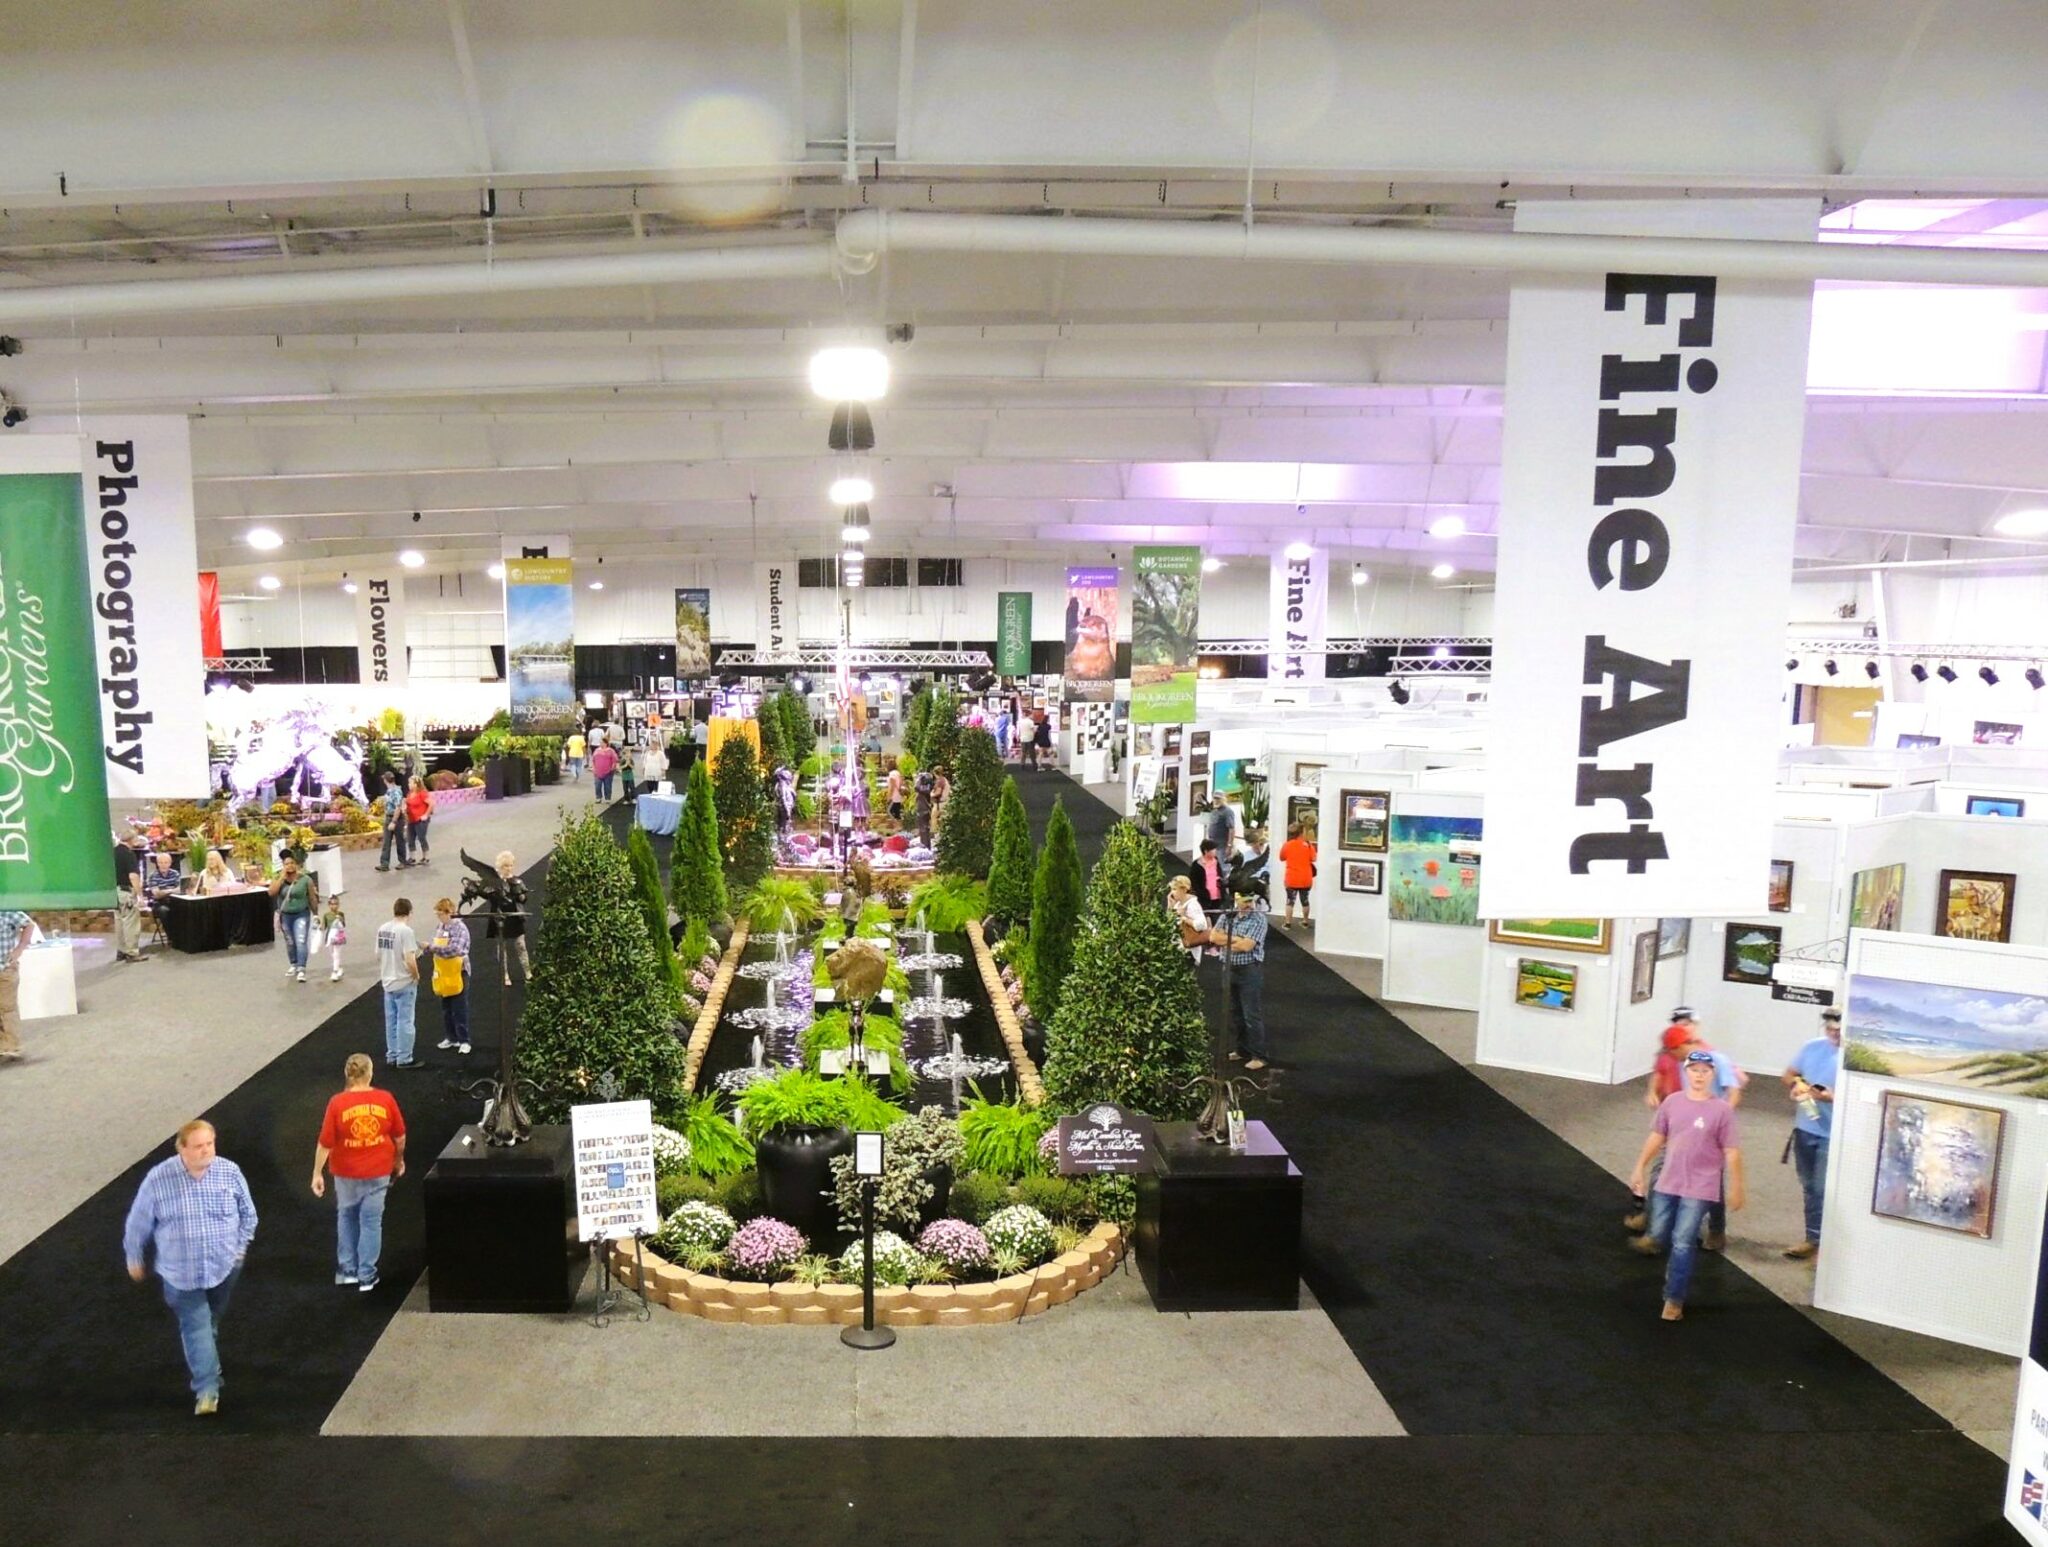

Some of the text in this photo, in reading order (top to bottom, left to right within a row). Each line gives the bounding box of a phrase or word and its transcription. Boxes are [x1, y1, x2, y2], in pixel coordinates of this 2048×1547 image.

[97, 440, 153, 775] Photography
[769, 568, 783, 631] Student
[1287, 557, 1311, 624] Fine
[1569, 272, 1718, 874] Fine Art
[369, 579, 391, 682] Flowers
[1004, 596, 1016, 668] BROOKGREEN
[513, 704, 574, 714] BROOKGREEN
